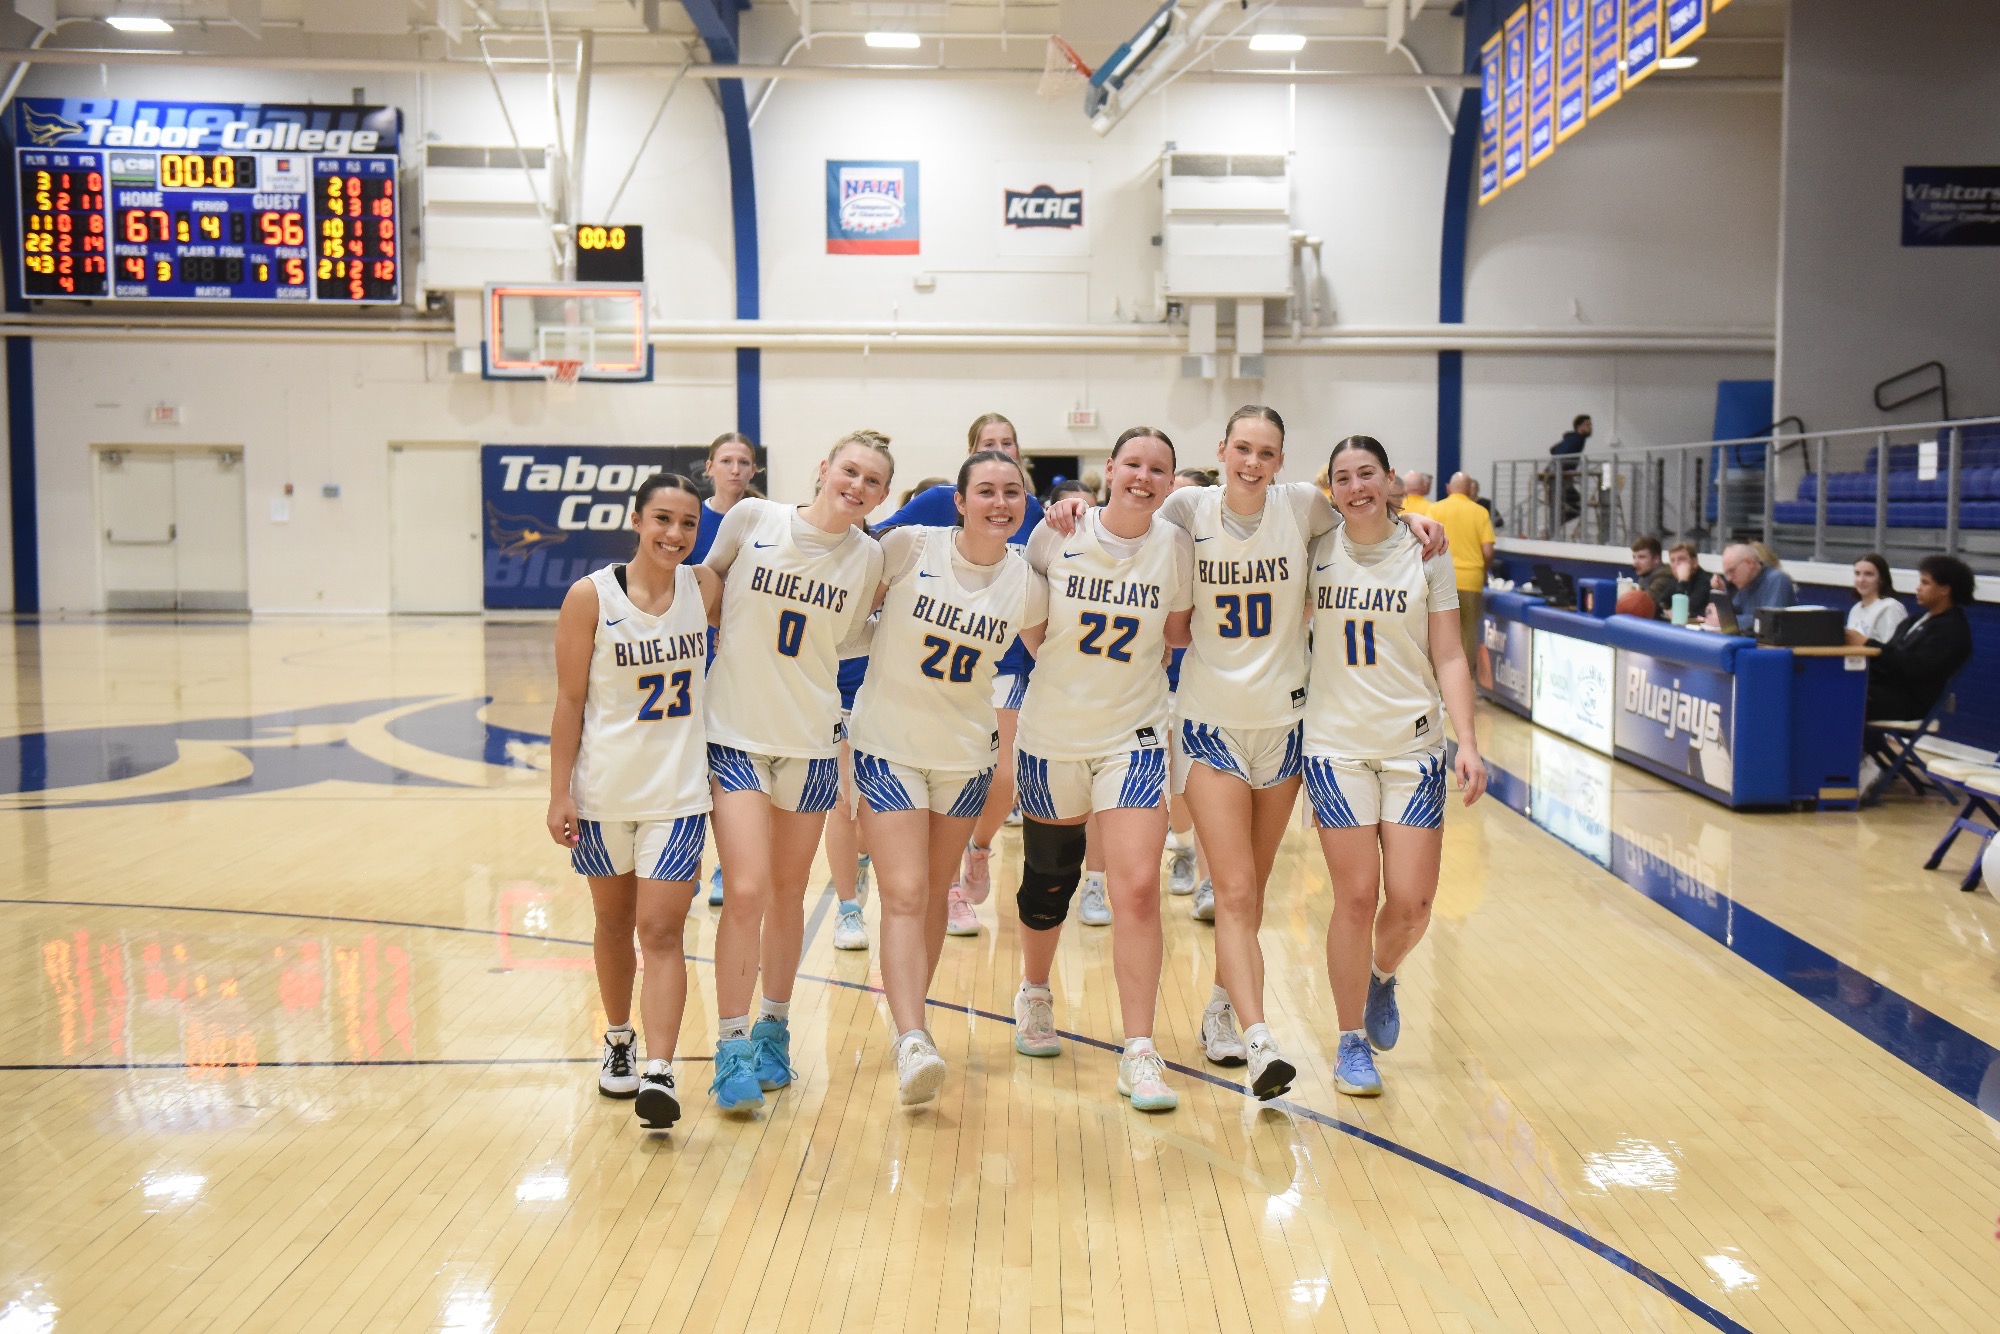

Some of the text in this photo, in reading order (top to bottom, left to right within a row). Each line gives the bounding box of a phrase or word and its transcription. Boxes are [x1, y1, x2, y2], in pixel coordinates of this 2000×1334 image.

[85, 119, 380, 155] Tabor College
[79, 156, 96, 167] PTS
[162, 155, 235, 188] 00.0
[370, 161, 387, 173] PTS
[37, 170, 102, 191] 3 1 0
[327, 176, 393, 197] 2 0 1
[844, 180, 901, 201] NAIA
[36, 191, 102, 210] 5 2 11
[120, 191, 163, 207] HOME
[192, 200, 229, 212] PERIOD
[252, 194, 300, 210] GUEST
[328, 198, 393, 217] 4 3 18
[1007, 197, 1080, 219] KCAC
[31, 214, 104, 233] 11 0 8
[126, 210, 170, 242] 67
[201, 215, 220, 239] 4
[261, 212, 304, 245] 56
[323, 218, 394, 239] 10 1 0
[25, 233, 104, 252] 22 2 14
[323, 239, 394, 258] 15 4 4
[579, 226, 626, 250] 00.0
[115, 245, 148, 256] FOULS
[177, 246, 245, 258] PLAYER FOUL
[275, 247, 308, 259] FOULS
[26, 255, 105, 273] 43 2 17
[126, 258, 145, 280] 4
[157, 261, 171, 281] 3
[259, 264, 268, 281] 1
[286, 258, 304, 284] 5
[318, 259, 394, 280] 21 2 12
[59, 277, 74, 292] 4
[195, 286, 231, 297] MATCH
[349, 280, 364, 300] 5
[499, 455, 662, 492] Tabor
[557, 495, 638, 531] Col
[1198, 556, 1290, 585] BLUEJAYS
[751, 566, 848, 613] BLUEJAYS
[1065, 575, 1160, 609] BLUEJAYS
[1317, 586, 1408, 614] BLUEJAYS
[913, 594, 1008, 644] BLUEJAYS
[1214, 591, 1273, 639] 30
[776, 608, 808, 658] 0
[1078, 609, 1141, 664] 22
[1343, 619, 1378, 667] 11
[614, 632, 705, 667] BLUEJAYS
[920, 632, 983, 683] 20
[636, 668, 694, 722] 23
[1625, 665, 1722, 750] Bluejays
